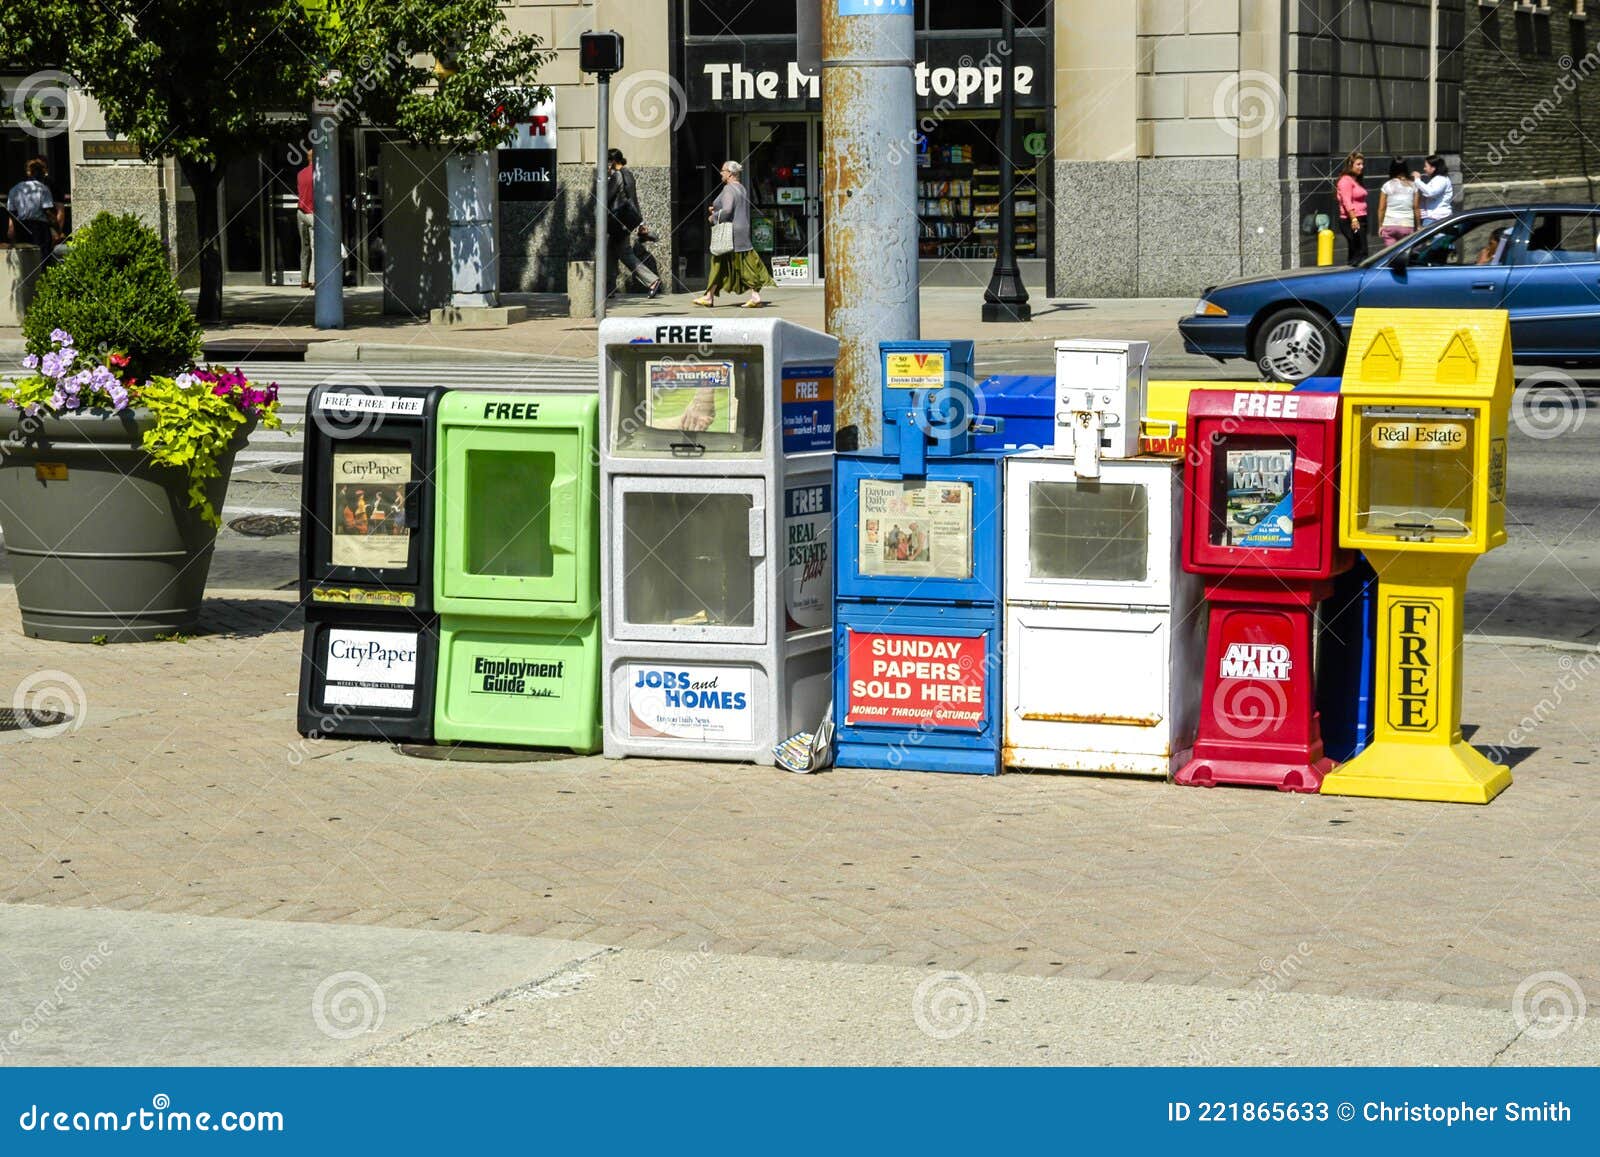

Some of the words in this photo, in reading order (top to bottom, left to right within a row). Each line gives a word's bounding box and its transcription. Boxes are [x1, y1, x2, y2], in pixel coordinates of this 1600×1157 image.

[703, 63, 779, 100] The
[915, 61, 1034, 104] toppe
[498, 168, 551, 186] eyBank
[656, 325, 713, 343] FREE
[796, 381, 819, 399] FREE
[325, 396, 352, 407] FREE
[358, 399, 384, 408] FREE
[391, 401, 418, 411] FREE
[484, 402, 540, 420] FREE
[1232, 392, 1300, 419] FREE
[1378, 426, 1409, 441] Real
[1416, 427, 1461, 443] Estate
[342, 460, 402, 479] CityPaper
[1238, 456, 1285, 472] AUTO
[865, 487, 896, 498] Dayton
[1233, 471, 1287, 494] MART
[793, 486, 823, 515] FREE
[865, 496, 887, 506] Daily
[865, 505, 887, 513] News
[788, 522, 817, 544] REAL
[788, 543, 828, 567] ESTATE
[330, 639, 416, 669] CityPaper
[872, 638, 961, 659] SUNDAY
[1224, 643, 1290, 662] AUTO
[474, 657, 564, 680] Employment
[872, 660, 961, 681] PAPERS
[1220, 659, 1292, 680] MART
[1397, 604, 1431, 728] FREE
[483, 674, 526, 693] Guide
[635, 670, 691, 690] JOBS
[692, 676, 719, 691] and
[665, 690, 747, 710] HOMES
[852, 679, 912, 700] SOLD
[921, 683, 982, 703] HERE
[851, 705, 889, 715] MONDAY
[892, 707, 934, 718] THROUGH
[935, 709, 983, 721] SATURDAY
